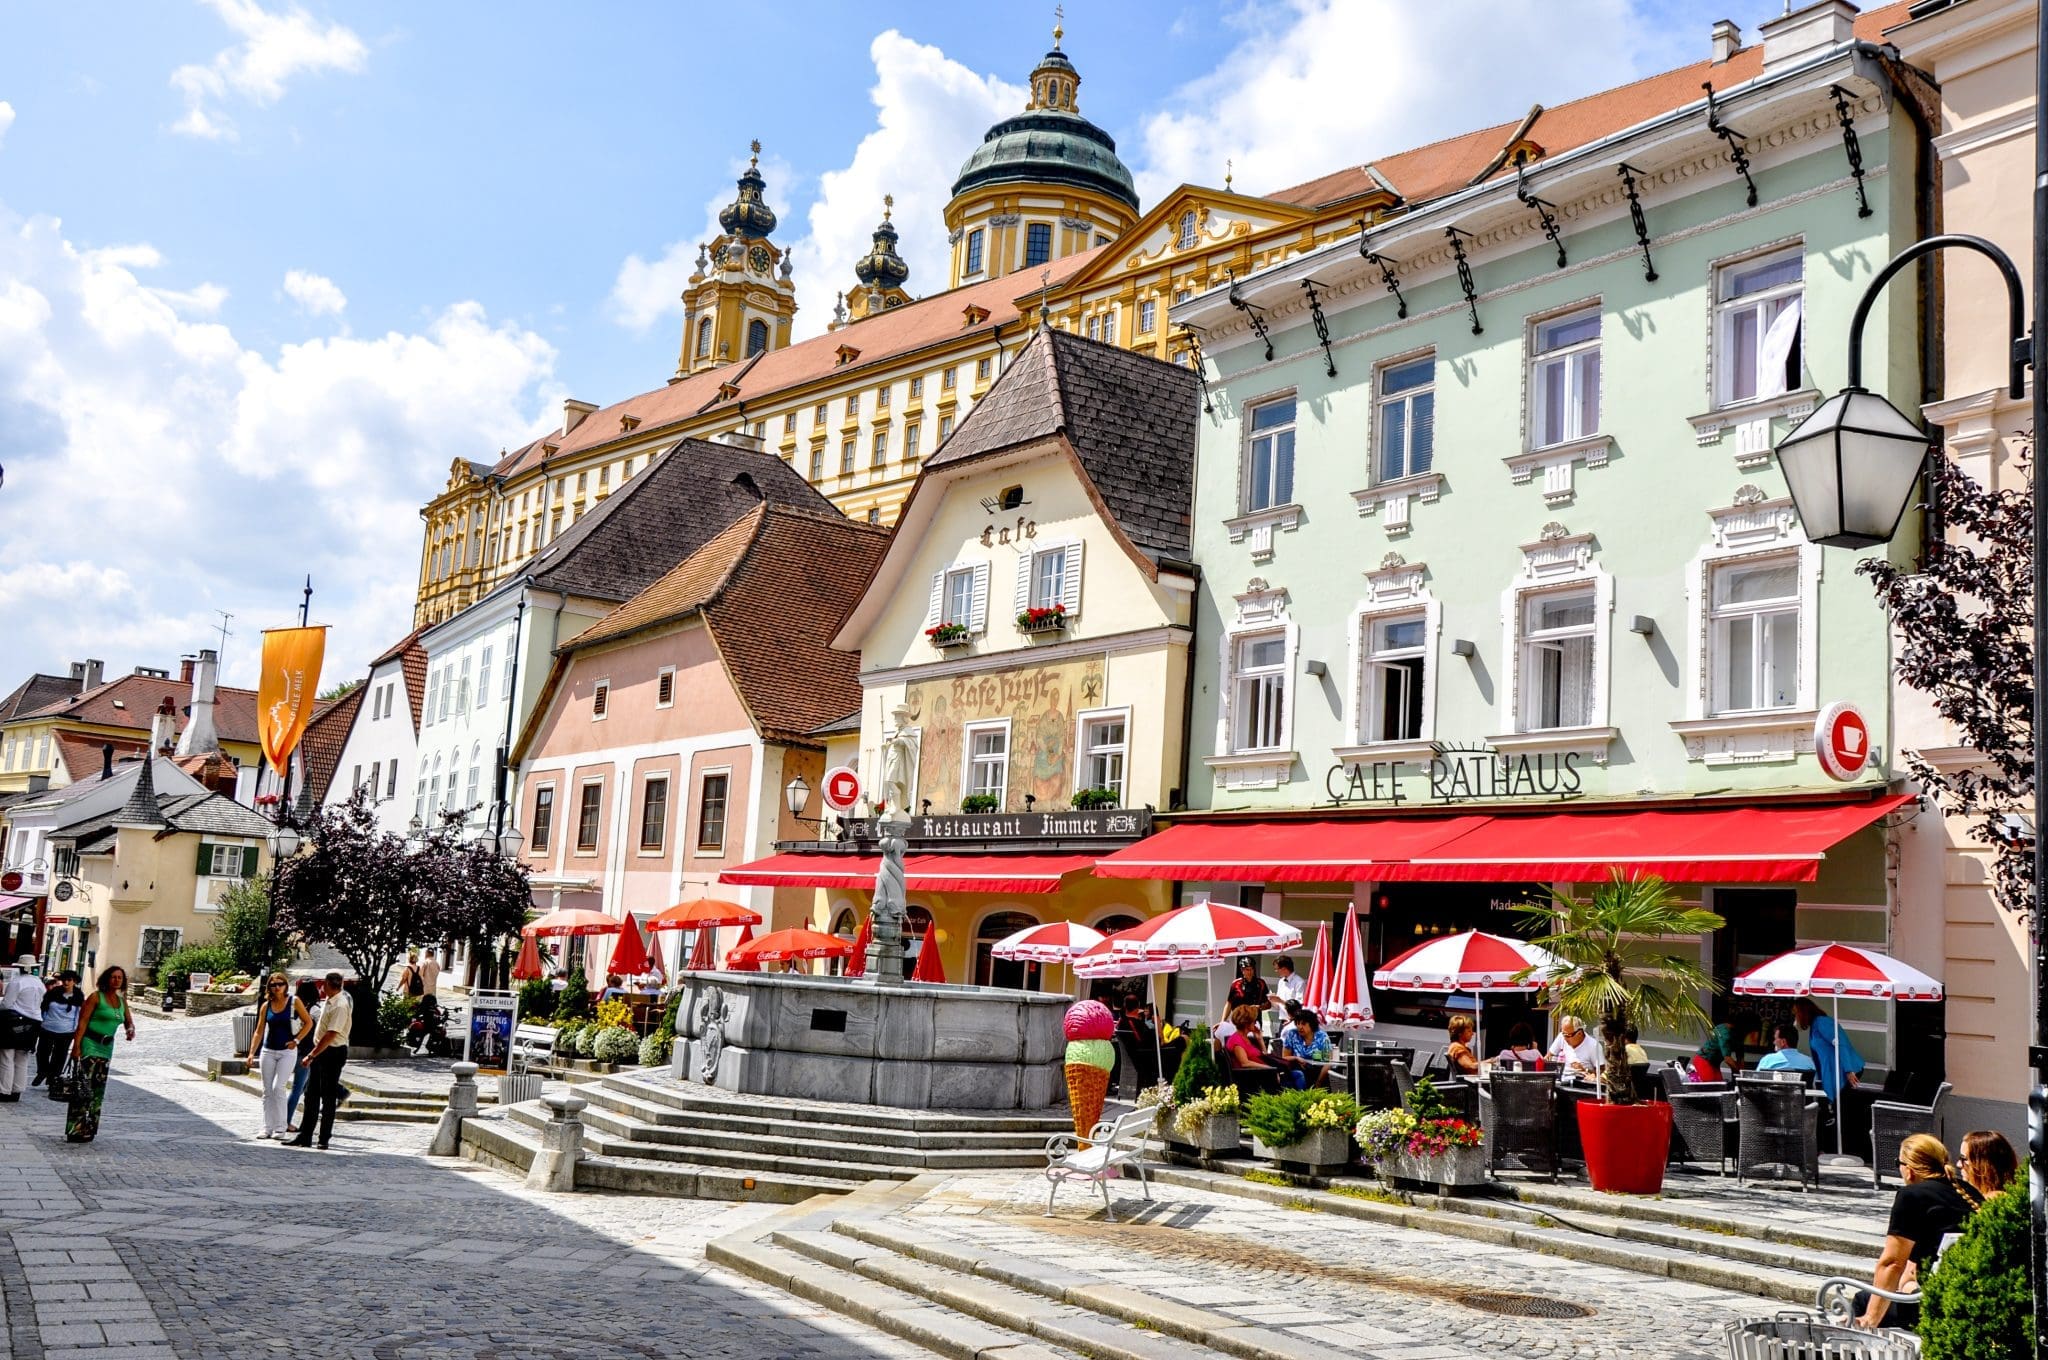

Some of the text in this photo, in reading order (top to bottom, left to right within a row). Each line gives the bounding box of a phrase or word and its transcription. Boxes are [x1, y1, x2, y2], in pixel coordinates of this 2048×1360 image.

[1327, 751, 1581, 801] CAFE RATHAUS
[923, 817, 1021, 838] Restaurant
[1041, 813, 1098, 836] Zimmer
[757, 951, 782, 961] Coca-Cola
[803, 947, 827, 957] Coca-Cola
